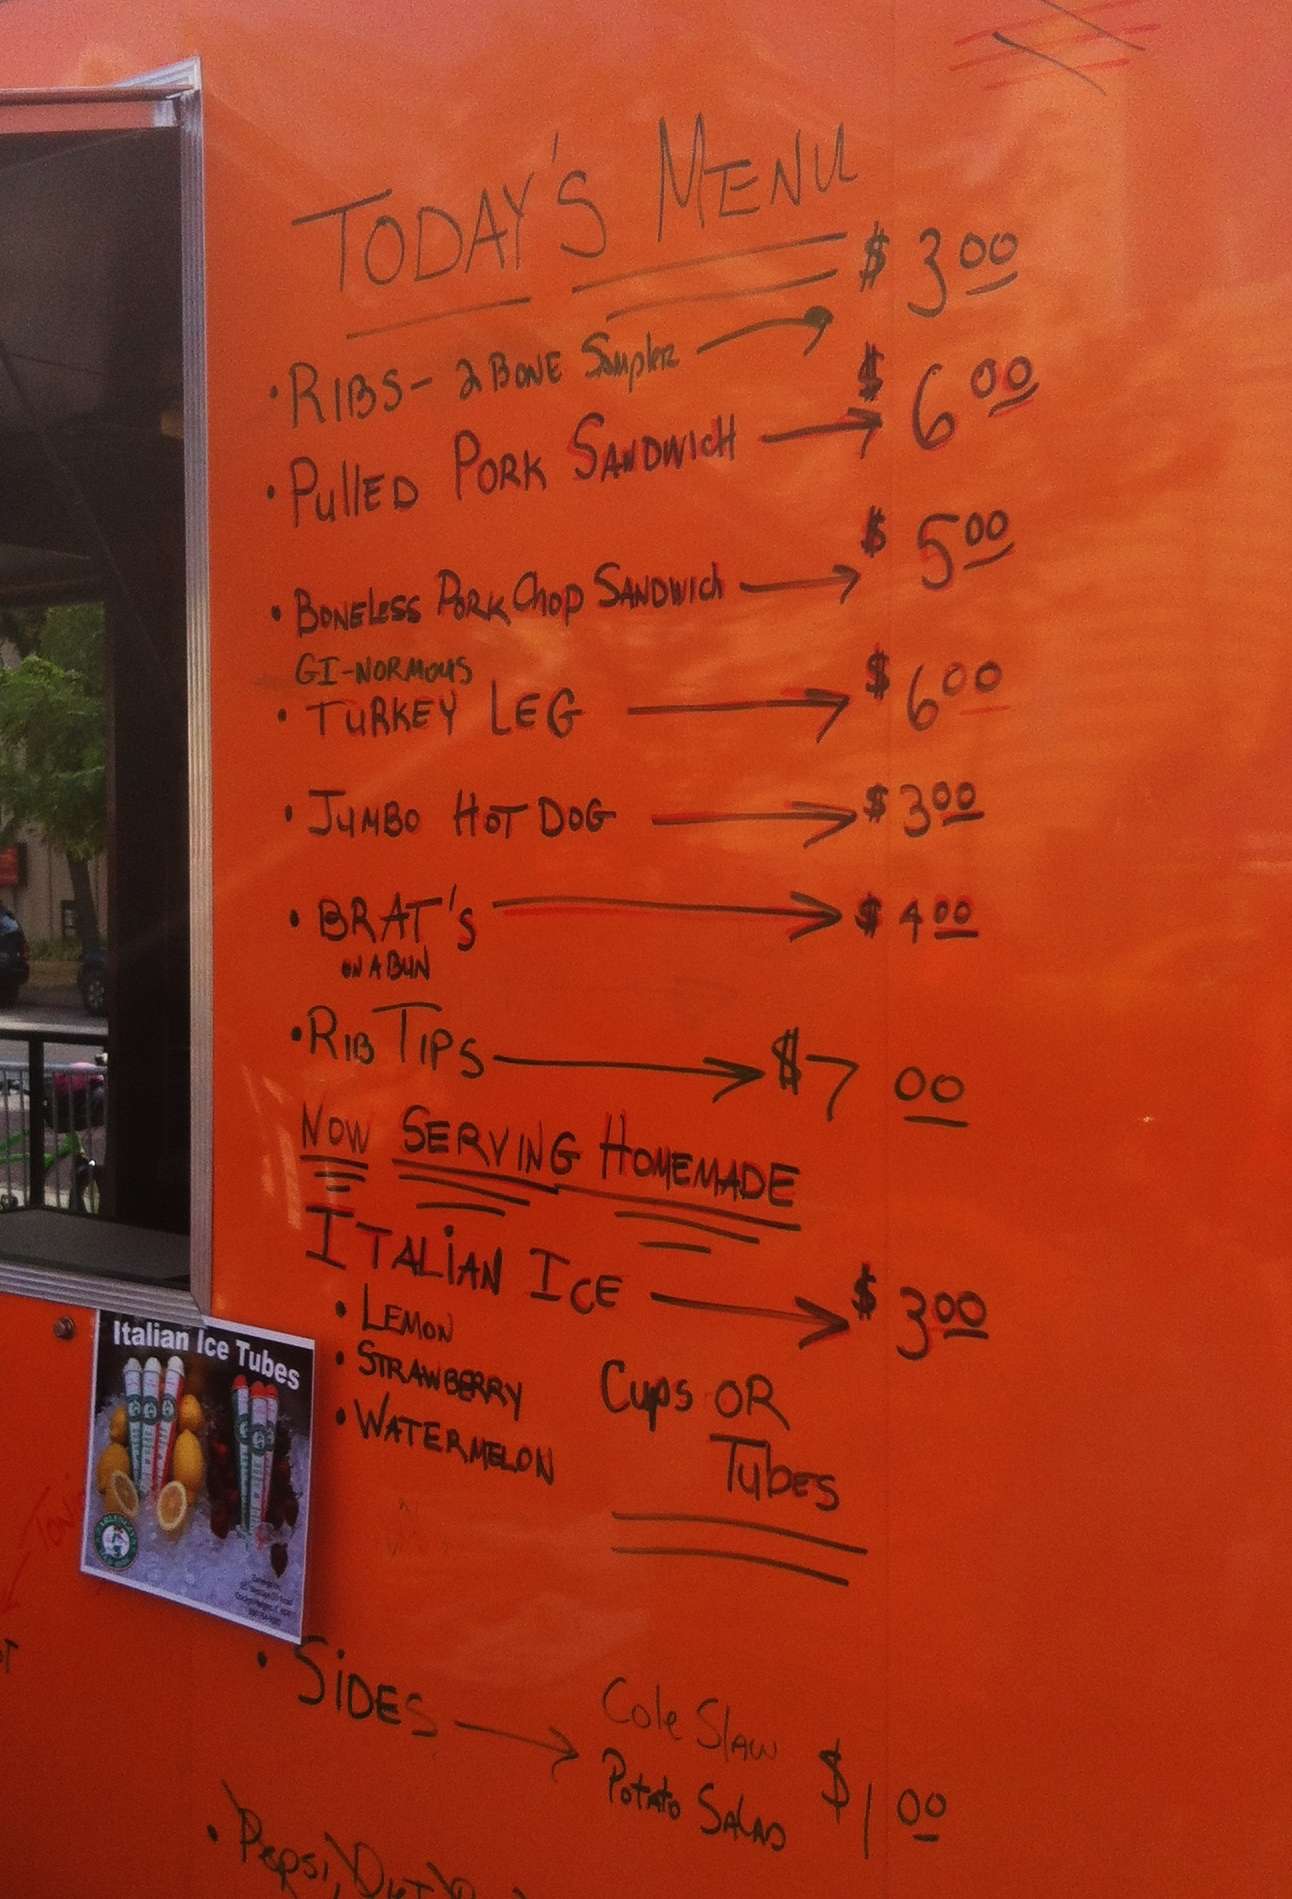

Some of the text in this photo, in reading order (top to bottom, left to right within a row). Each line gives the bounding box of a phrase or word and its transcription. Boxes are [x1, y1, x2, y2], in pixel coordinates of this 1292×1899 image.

[292, 113, 857, 290] TODAY'S MENU
[456, 358, 482, 400] 2
[455, 433, 547, 498] PORK
[306, 681, 584, 738] TURKEY LEG
[308, 789, 421, 838] JUMBO
[455, 789, 529, 838] HOT
[539, 797, 617, 839] DOG
[369, 953, 381, 980] A
[372, 1001, 485, 1079] TIPS
[301, 1102, 800, 1206] NOW SERVING HOMEMADE
[530, 1247, 623, 1315] ICE
[362, 1285, 453, 1344] LEMON
[113, 1319, 301, 1391] Italian Ice Tubes
[358, 1339, 523, 1421] STRAWBERRY
[355, 1392, 554, 1485] WATERMELON
[602, 1676, 682, 1741] Cole
